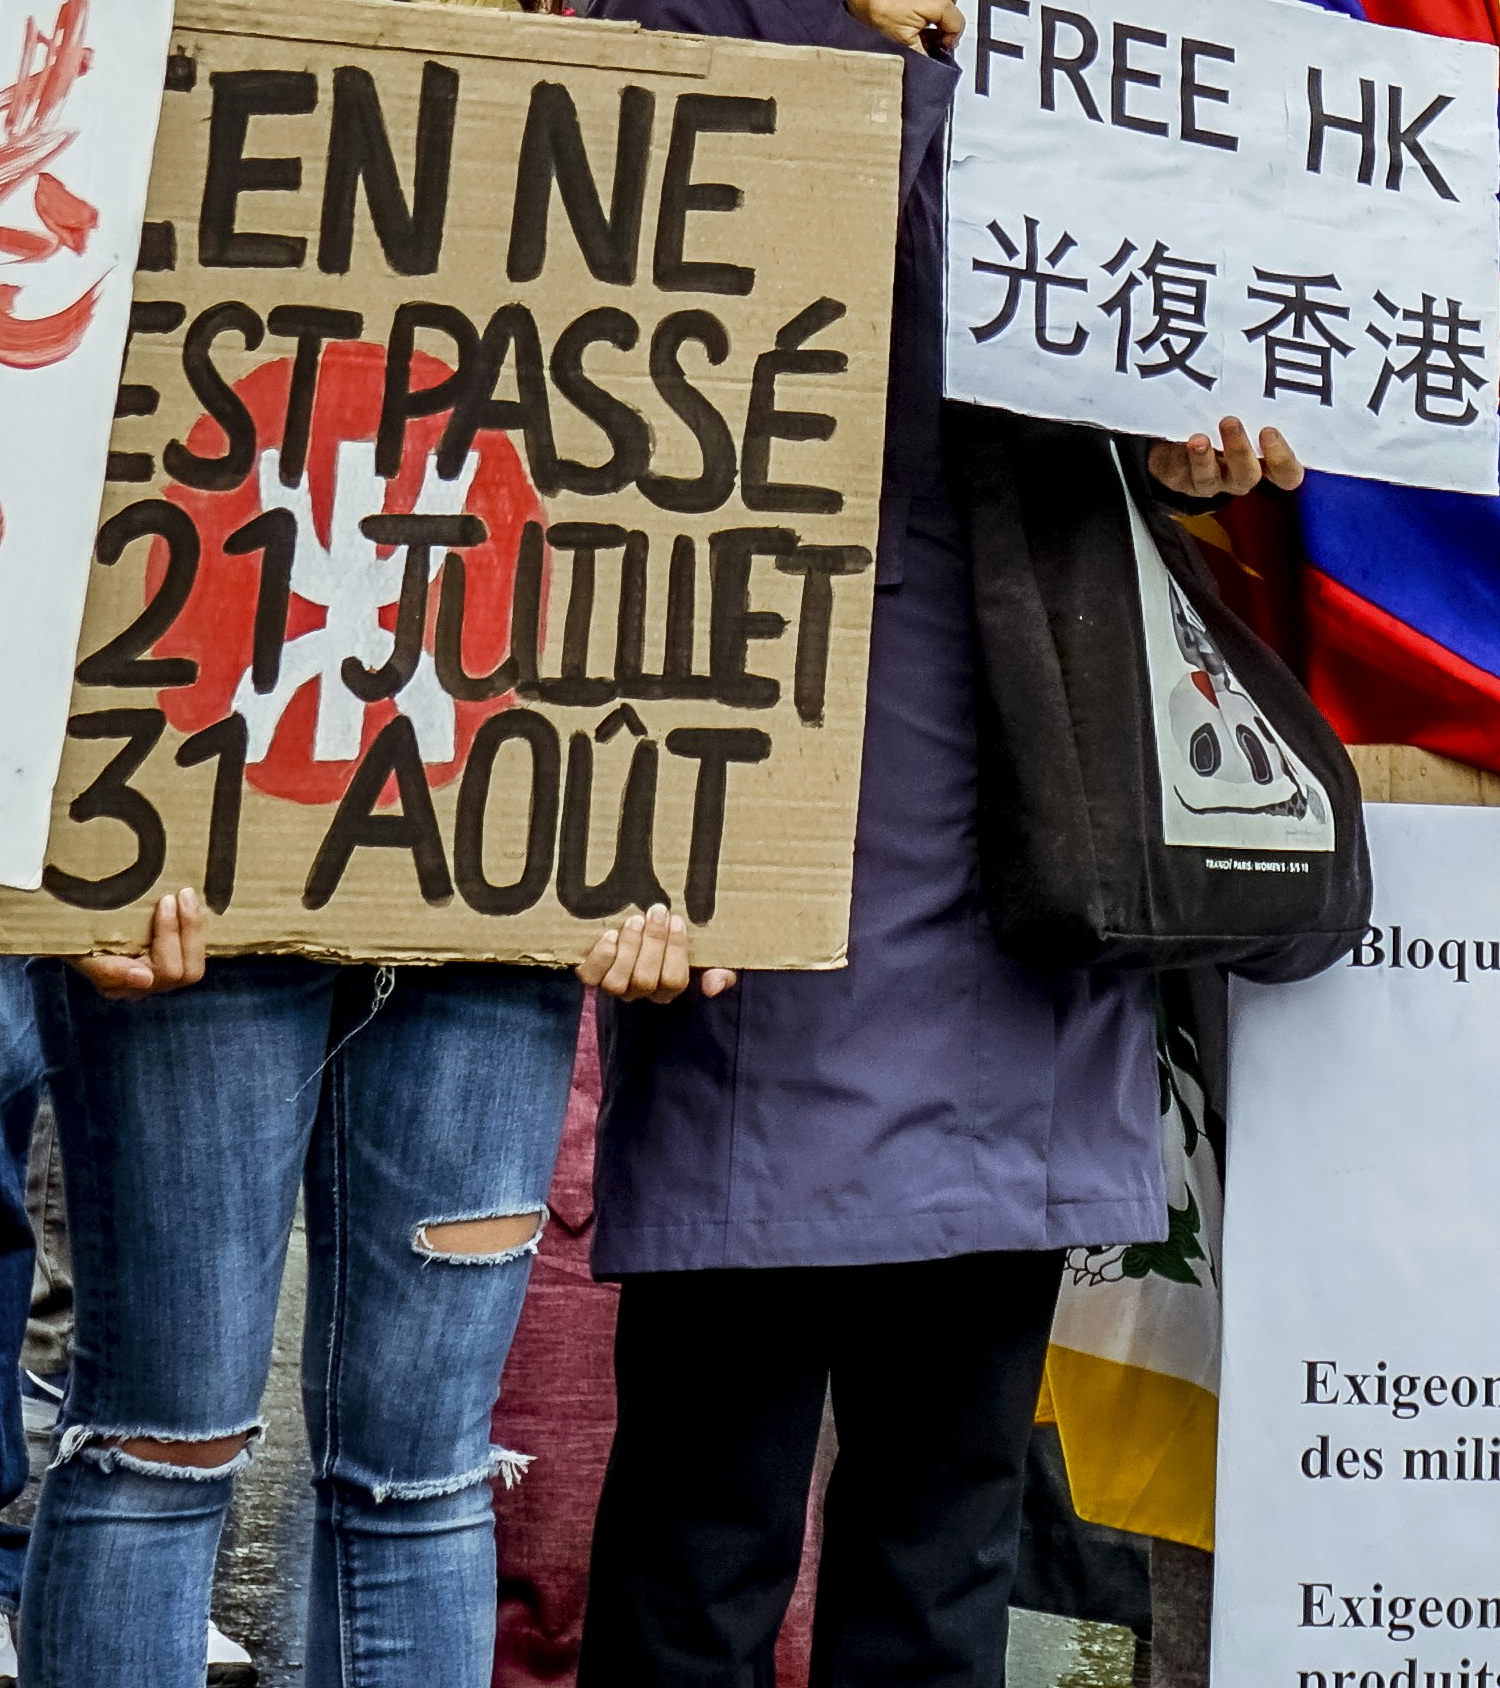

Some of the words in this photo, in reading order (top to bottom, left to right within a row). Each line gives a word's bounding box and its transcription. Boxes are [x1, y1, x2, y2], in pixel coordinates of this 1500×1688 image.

[140, 46, 458, 276] EN
[506, 79, 776, 293] NE
[1306, 67, 1459, 201] HK
[375, 296, 849, 512] PASSÉ
[970, 215, 1488, 426] 光復香港
[75, 499, 297, 693] 21
[342, 513, 871, 727] JUILLET
[43, 708, 248, 914] 31
[301, 703, 771, 924] AOÛT
[1301, 1435, 1383, 1479] des
